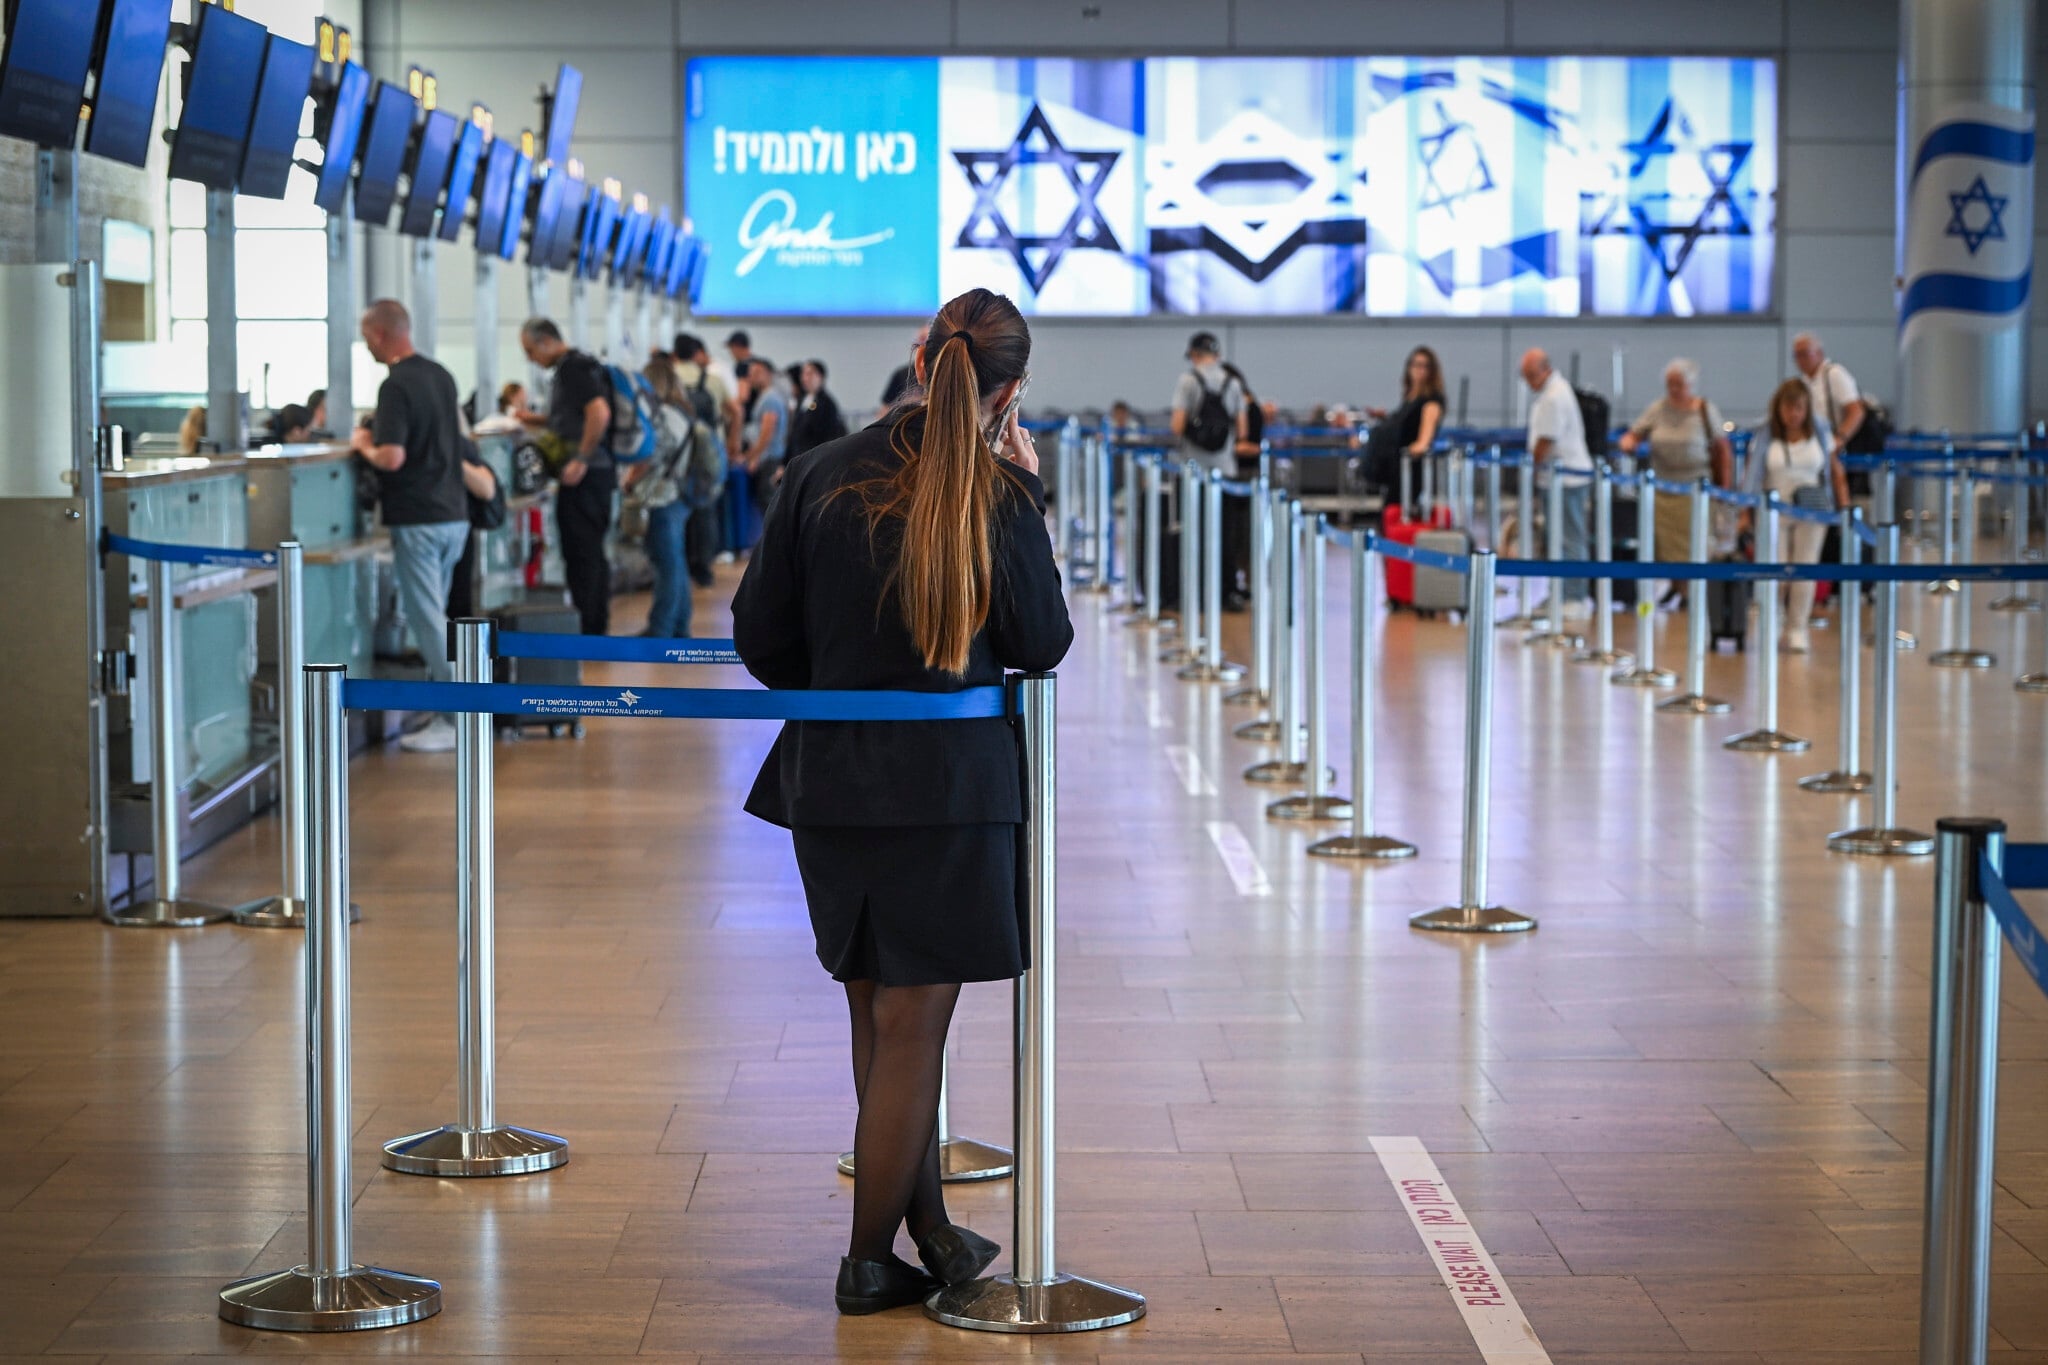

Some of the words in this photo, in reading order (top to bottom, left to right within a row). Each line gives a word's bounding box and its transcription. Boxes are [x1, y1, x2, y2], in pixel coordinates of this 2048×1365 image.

[713, 124, 845, 175] ולתמיד!
[855, 131, 917, 183] כאן
[536, 706, 578, 714] BEN-GURION
[579, 707, 632, 715] INTERNATIONAL
[632, 708, 664, 716] AIRPORT
[605, 699, 618, 707] נמל
[1400, 1179, 1455, 1206] המתן
[1416, 1208, 1468, 1226] כאן
[1434, 1240, 1481, 1264] WAIT
[1448, 1265, 1506, 1307] PLEASE
